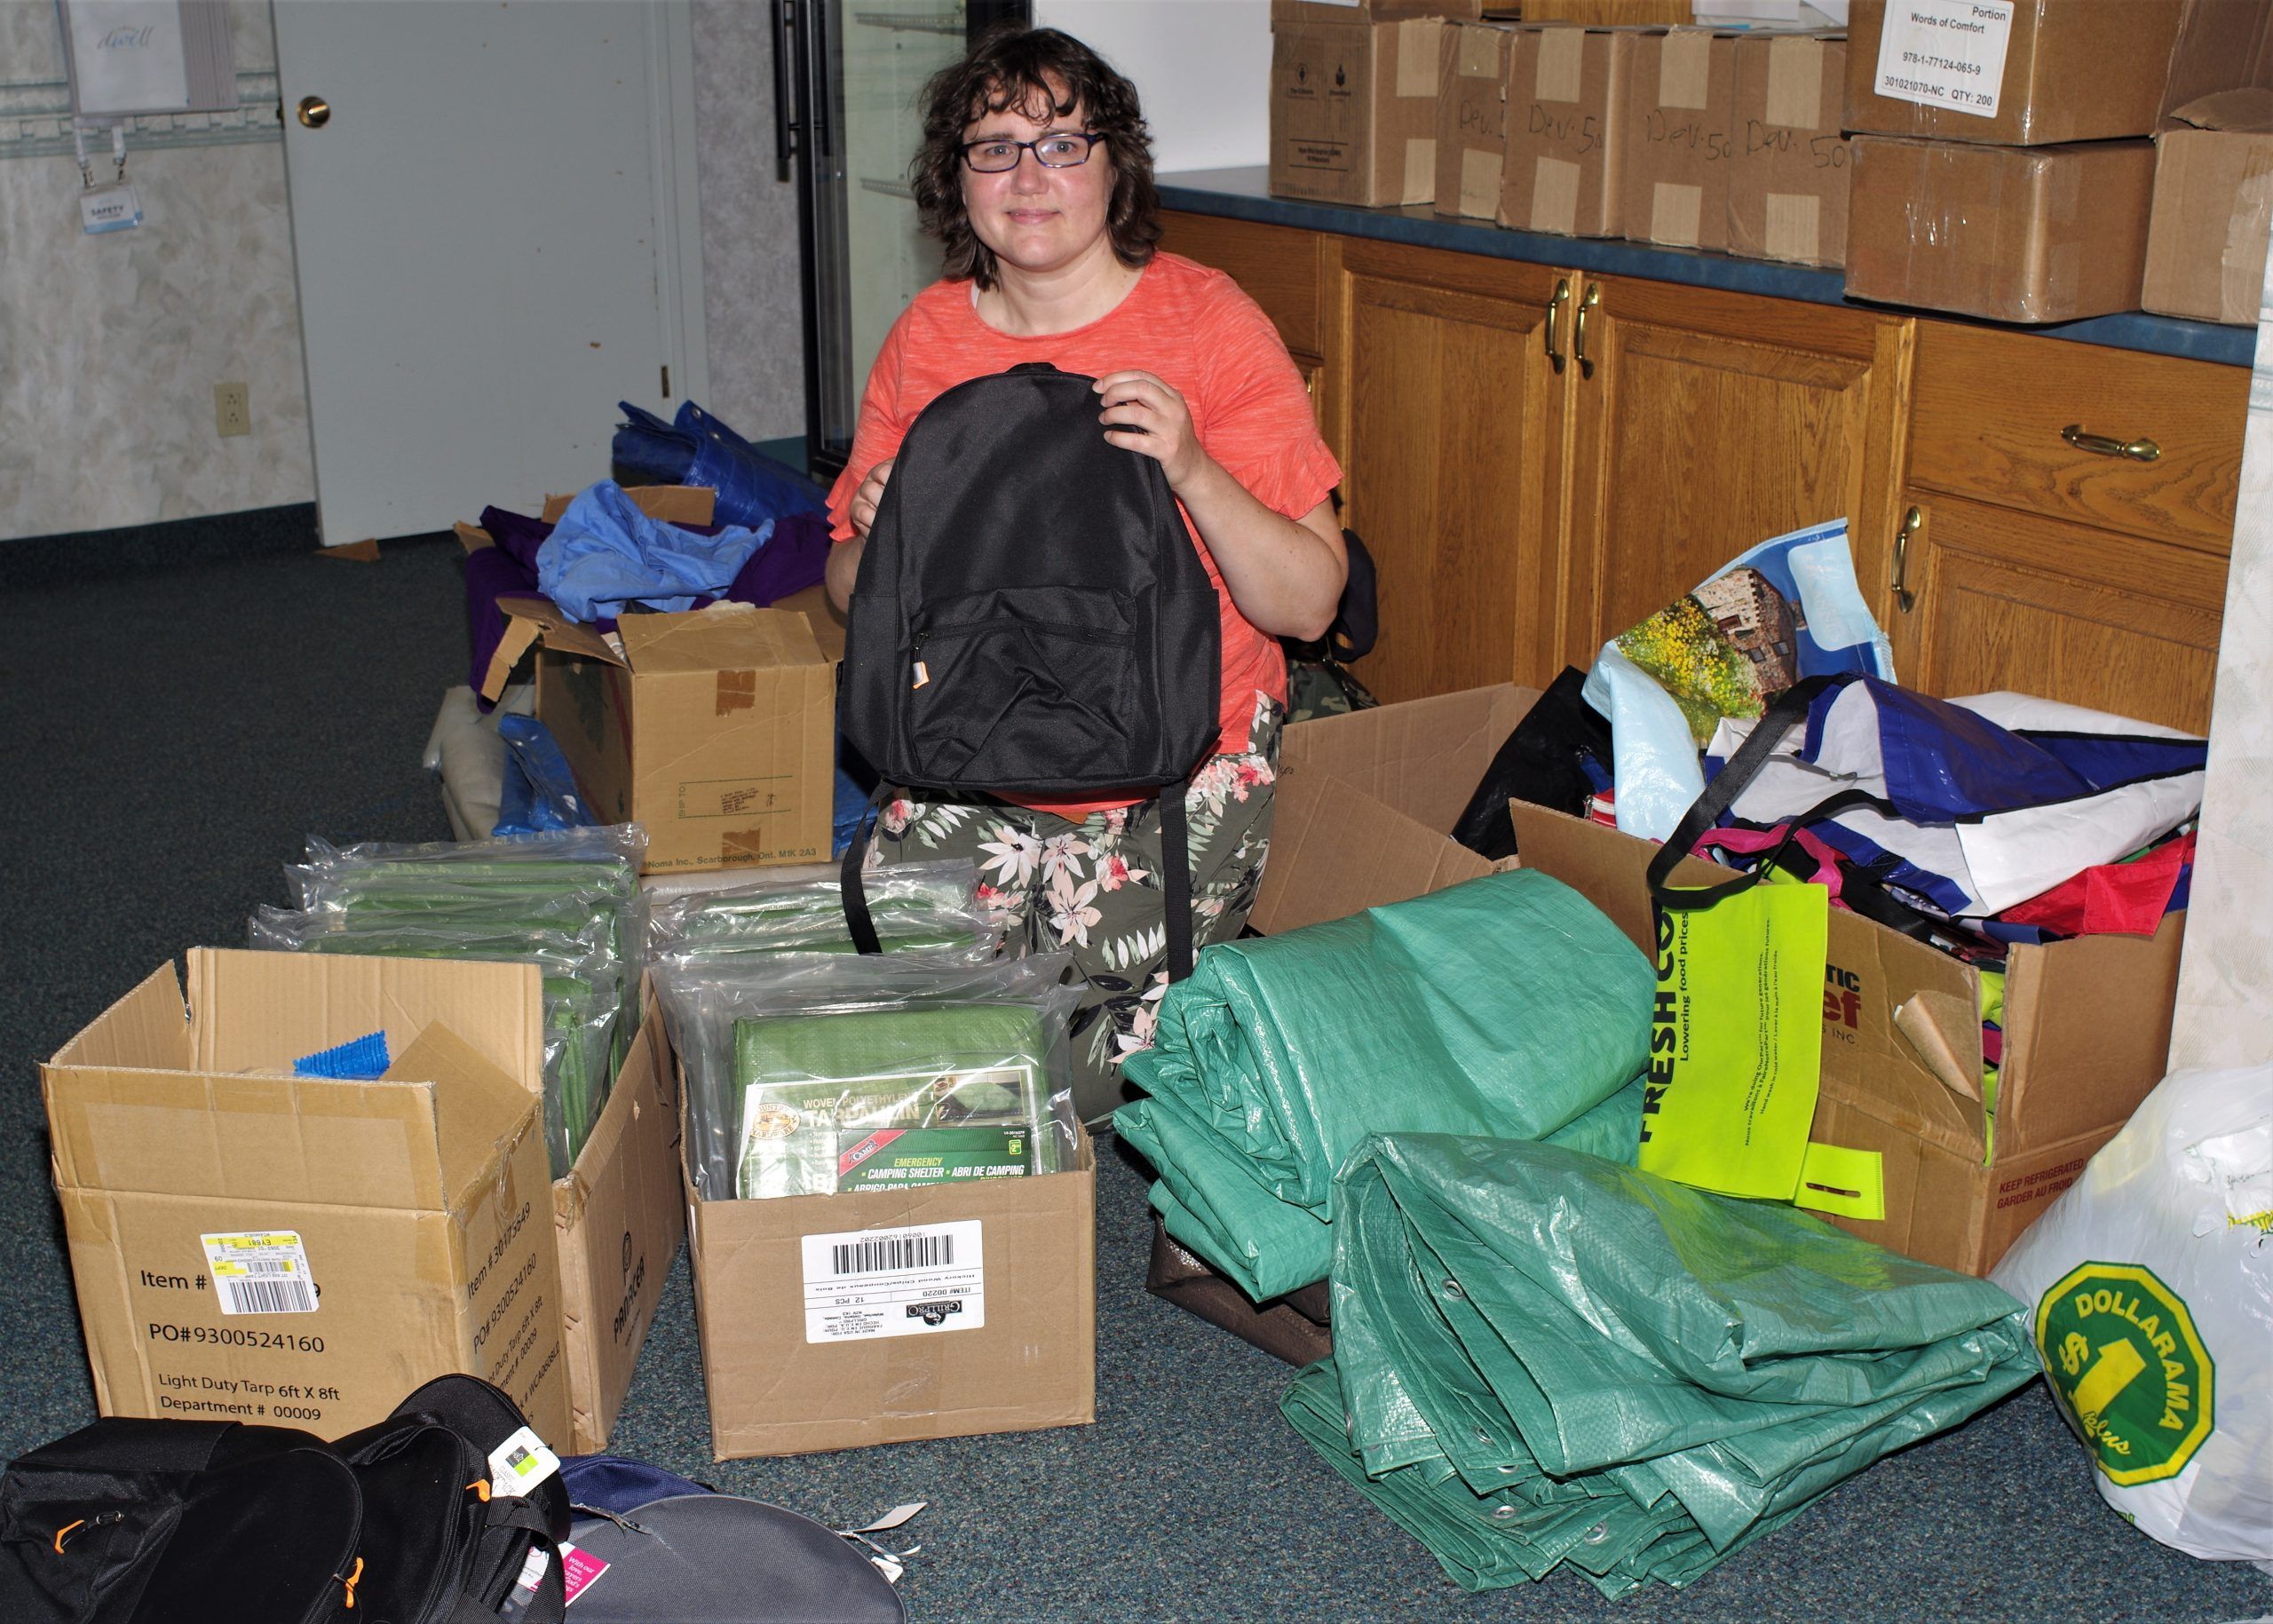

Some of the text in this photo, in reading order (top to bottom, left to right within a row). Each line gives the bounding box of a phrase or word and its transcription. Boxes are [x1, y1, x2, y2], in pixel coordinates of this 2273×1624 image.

[1911, 12, 1936, 26] Words
[1950, 20, 1984, 34] Comfort
[1972, 6, 2006, 20] Portion
[1903, 51, 1981, 75] 978-1-77124-065-9
[1884, 75, 1992, 107] 301021070-NC QTY: 200
[1810, 136, 1846, 168] 50
[648, 859, 673, 868] Noma
[696, 853, 755, 865] Scarborough,
[800, 848, 817, 857] 2A3
[1678, 911, 1689, 955] prices
[1680, 995, 1691, 1062] Lowering
[842, 1092, 916, 1106] POLYETHYLEN
[867, 1165, 1025, 1179] CAMPING SHELTER ABRI DE CAMPING
[894, 1157, 944, 1168] EMERGENCY
[2000, 1158, 2084, 1193] KEEP REFRIGERATED
[1997, 1177, 2073, 1208] GARDER AU FROID
[140, 1270, 207, 1290] Item #
[467, 1266, 487, 1300] Item
[923, 1288, 947, 1297] 00220
[907, 1301, 961, 1316] GRILLPRO
[495, 1349, 509, 1376] Duty
[509, 1331, 521, 1351] Tarp
[520, 1327, 537, 1360] 00009
[2075, 1289, 2190, 1430] DOLLARAMA
[158, 1374, 340, 1400] Light Duty Tarp 6ft X 8ft
[161, 1396, 321, 1421] Department # 00009
[565, 1570, 582, 1582] rayers
[568, 1557, 595, 1574] With our
